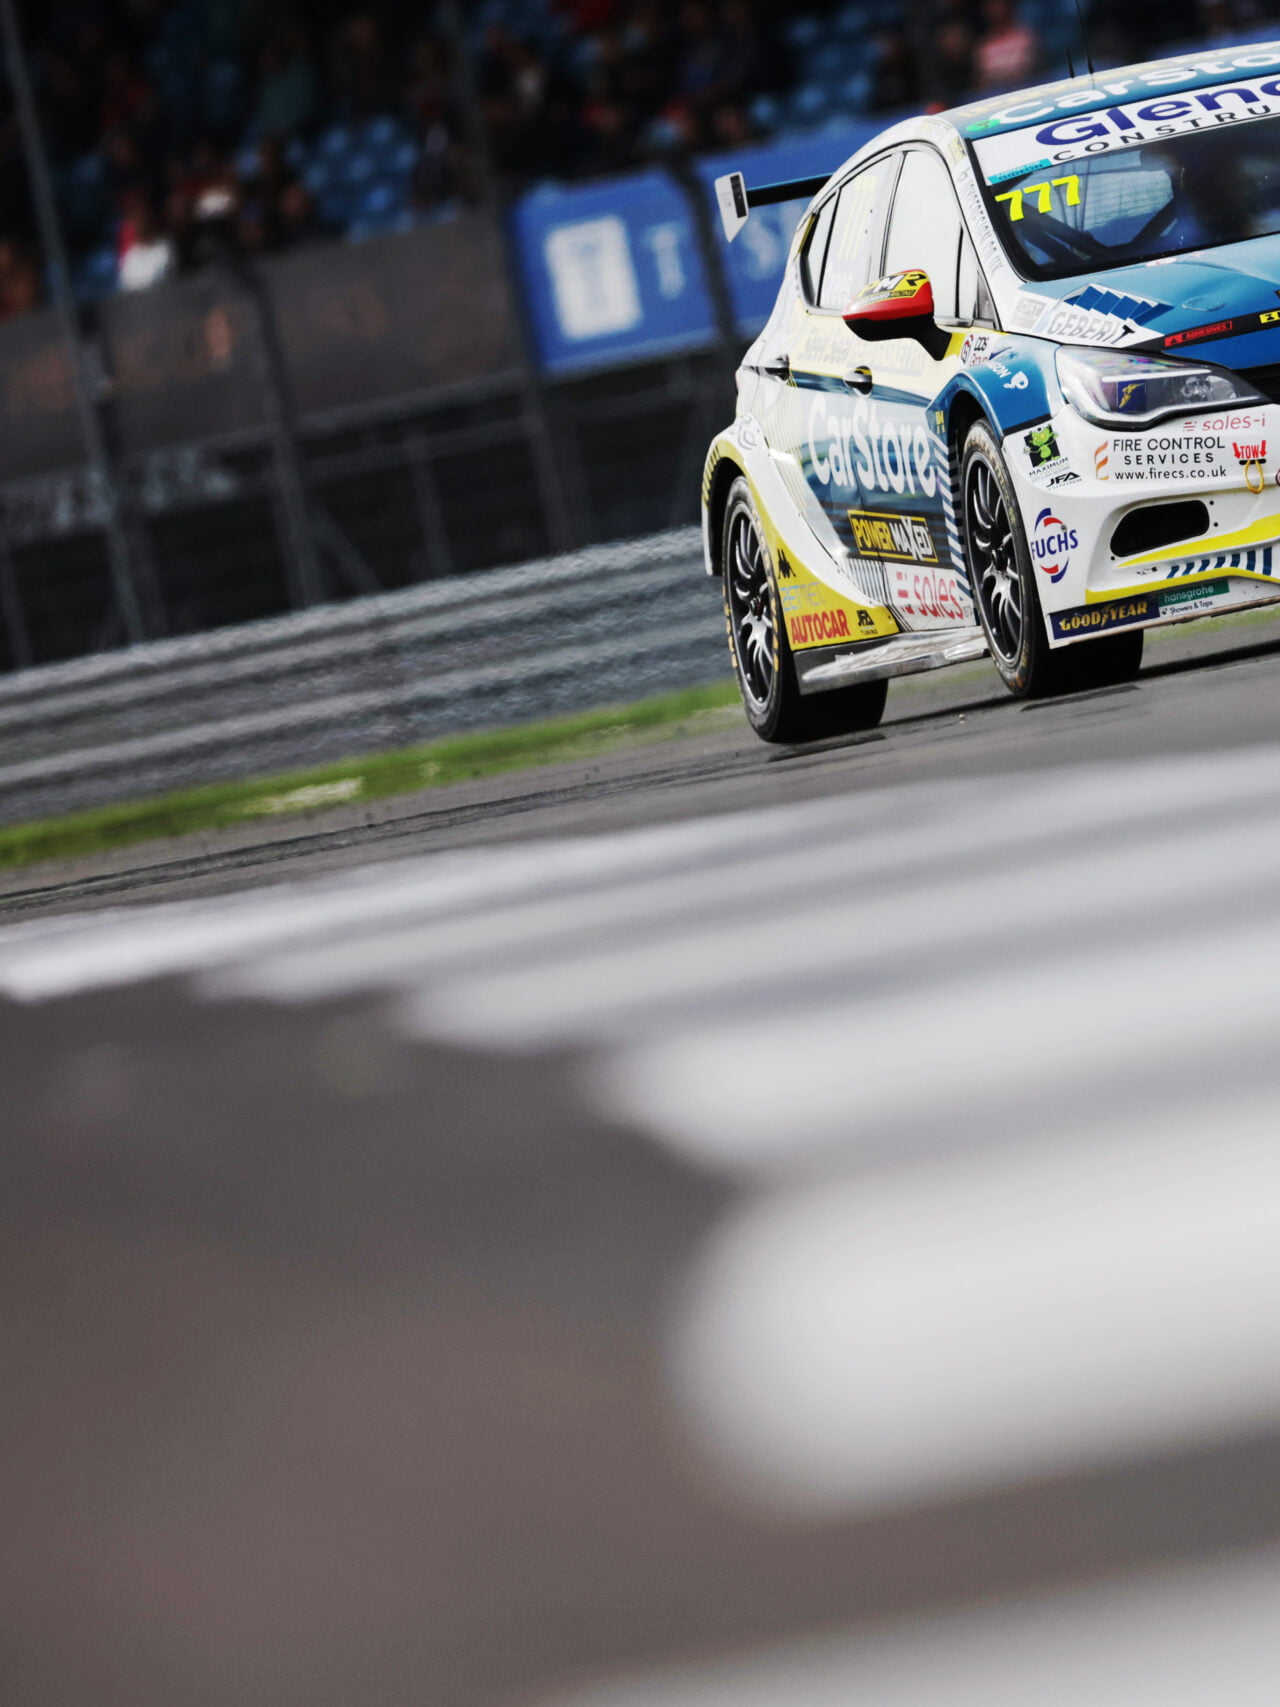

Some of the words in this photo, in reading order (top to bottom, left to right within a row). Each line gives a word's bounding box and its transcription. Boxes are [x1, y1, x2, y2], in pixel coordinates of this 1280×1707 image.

[994, 174, 1081, 222] 777
[1047, 311, 1136, 345] GEBERIT
[1201, 413, 1267, 431] sales-i
[808, 393, 938, 498] CarStore
[1113, 438, 1142, 452] FIRE
[1147, 436, 1225, 451] CONTROL
[1239, 444, 1260, 460] TOW
[1029, 456, 1069, 477] MAXIMUM
[1124, 452, 1214, 466] SERVICES
[1046, 471, 1082, 488] JFA
[1115, 466, 1227, 480] www.firecs.co.uk
[850, 517, 895, 551] POWER
[890, 516, 933, 561] MAXED
[1031, 529, 1079, 561] FUCHS
[1164, 584, 1214, 603] hansgrohe
[1059, 601, 1148, 632] GOODYEAR
[1169, 603, 1193, 614] Showers
[1200, 600, 1214, 609] Taps
[790, 609, 851, 645] AUTOCAR
